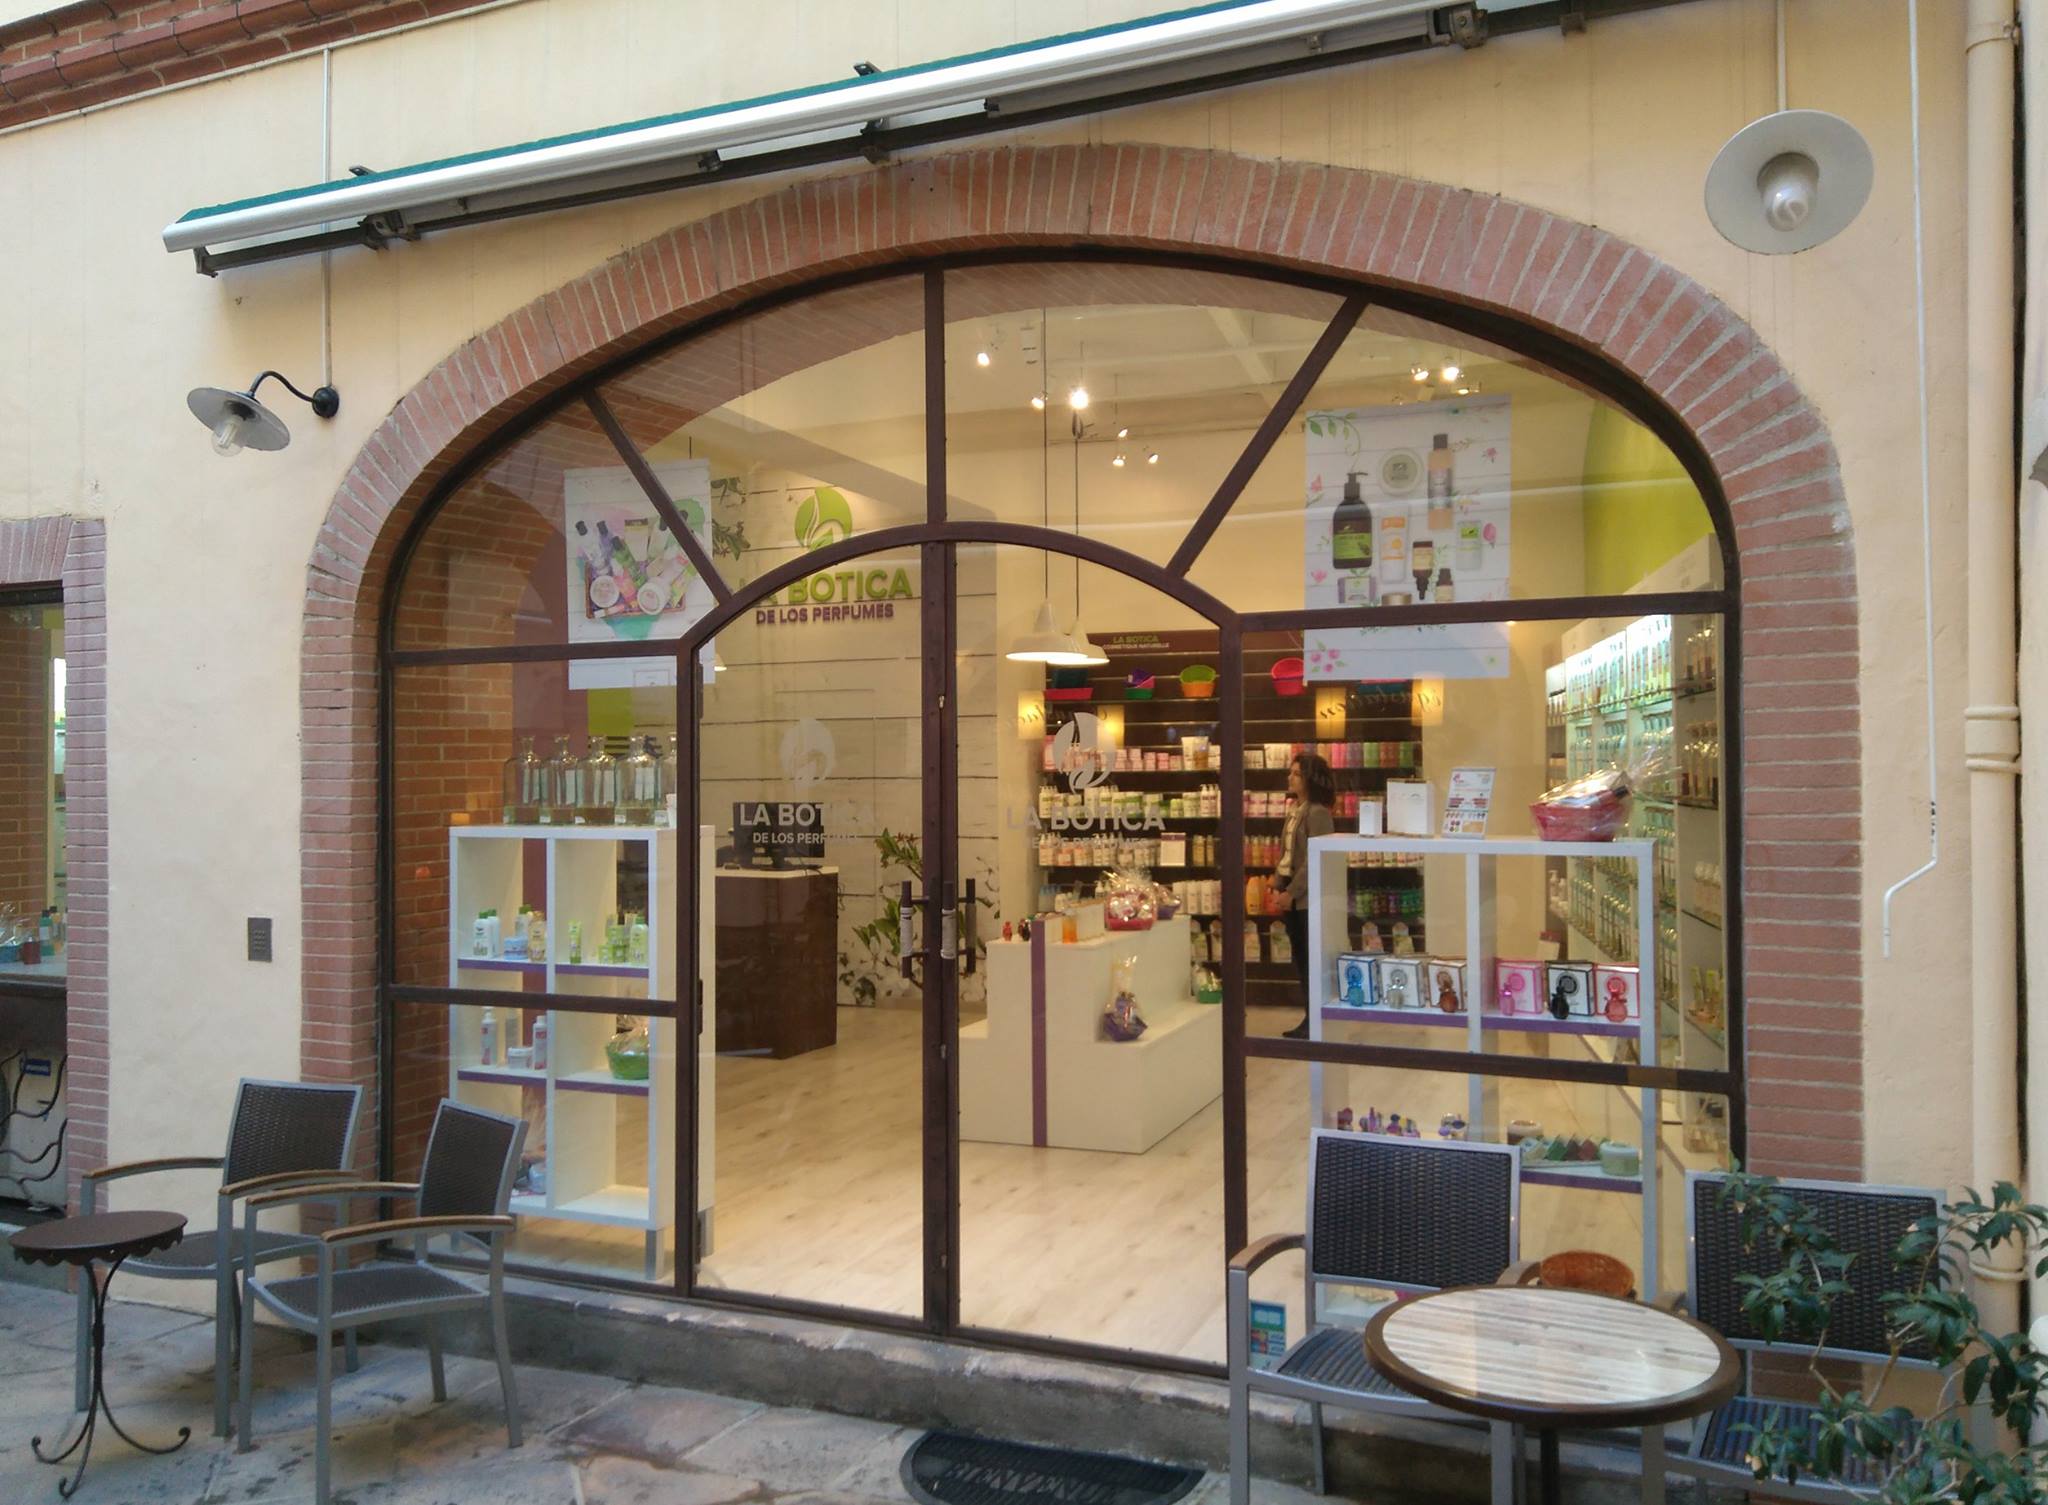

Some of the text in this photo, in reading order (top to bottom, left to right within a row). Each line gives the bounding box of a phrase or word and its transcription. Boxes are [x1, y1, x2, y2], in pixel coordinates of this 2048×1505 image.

[788, 567, 913, 604] BOTICA
[756, 603, 894, 625] DE LOS PERFUMES
[739, 803, 771, 827] LA
[1006, 804, 1167, 831] LA BOTICA
[752, 832, 769, 844] DE
[771, 832, 794, 844] LOS
